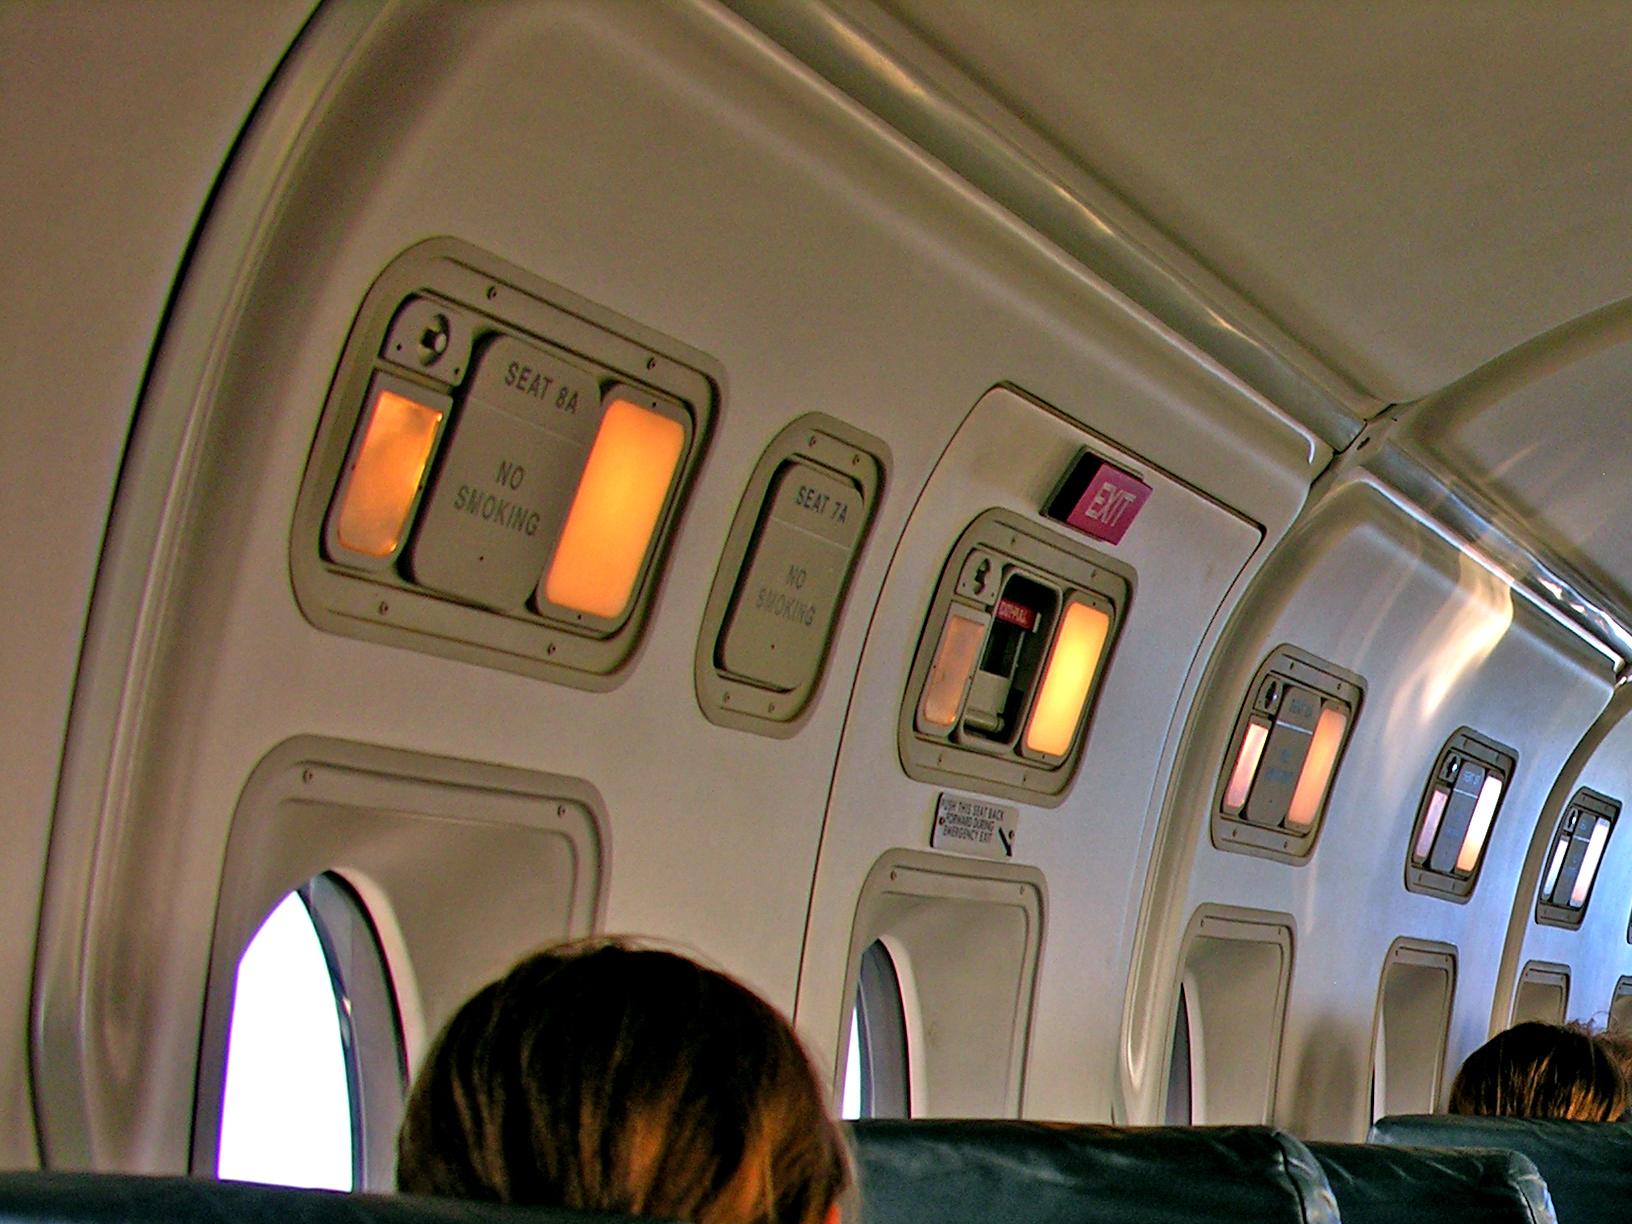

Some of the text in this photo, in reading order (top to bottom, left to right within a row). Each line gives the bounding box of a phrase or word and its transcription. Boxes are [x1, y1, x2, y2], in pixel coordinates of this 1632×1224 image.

[504, 361, 579, 415] SEAT 8A
[496, 460, 525, 491] NO
[453, 484, 541, 537] SMOKING
[795, 485, 849, 525] SEAT 7A
[1085, 481, 1137, 527] EXIT
[785, 564, 807, 590] NO
[755, 587, 817, 627] SMOKING
